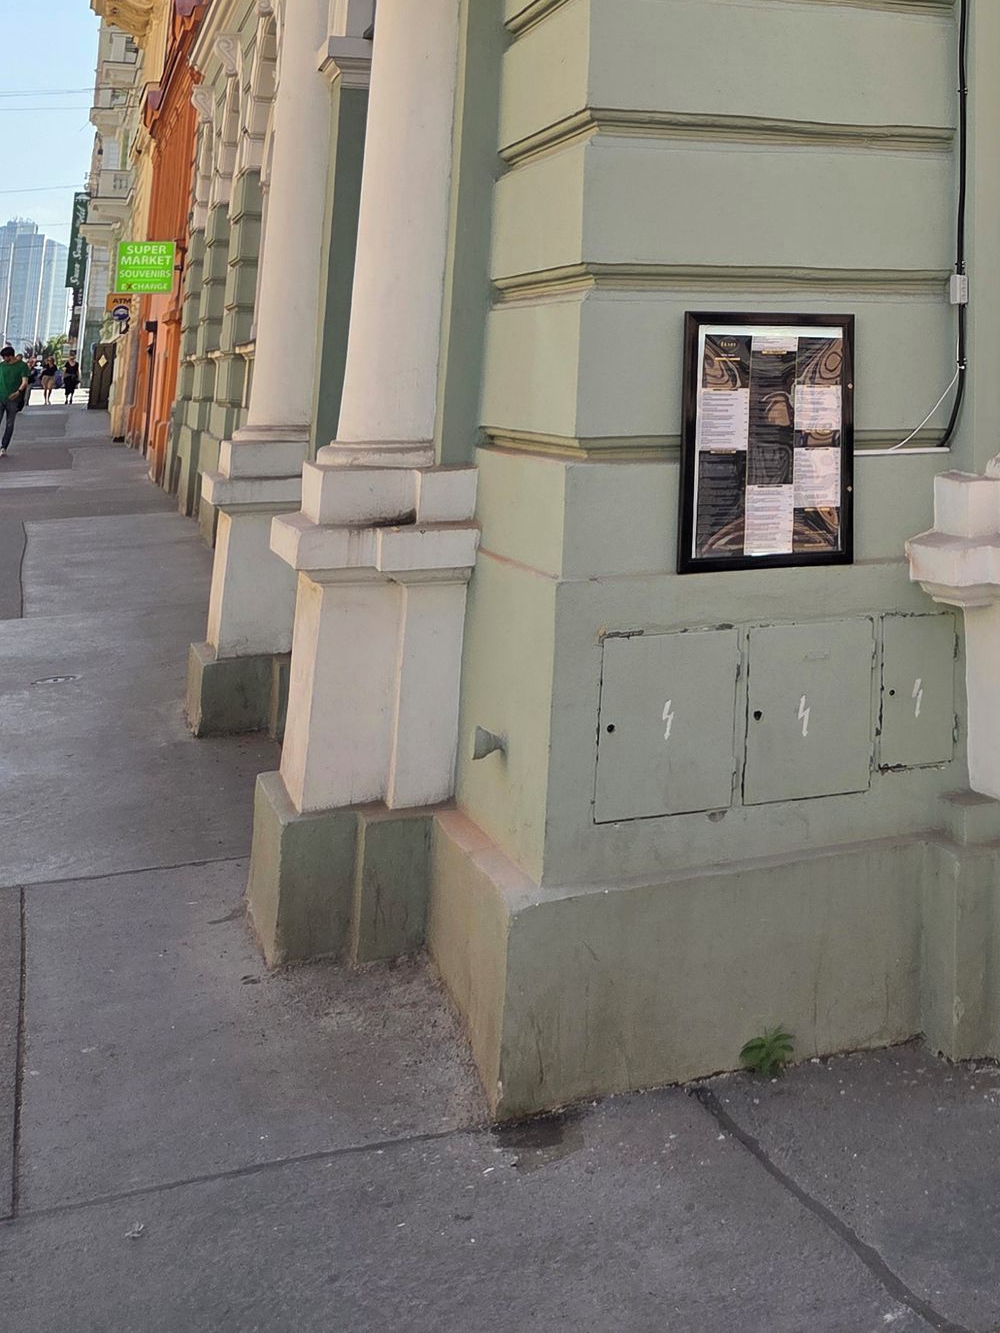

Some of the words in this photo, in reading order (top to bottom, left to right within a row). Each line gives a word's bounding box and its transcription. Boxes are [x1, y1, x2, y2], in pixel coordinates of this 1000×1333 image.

[127, 245, 167, 255] SUPER
[121, 255, 172, 266] MARKET
[119, 269, 171, 278] SOUVENIRS
